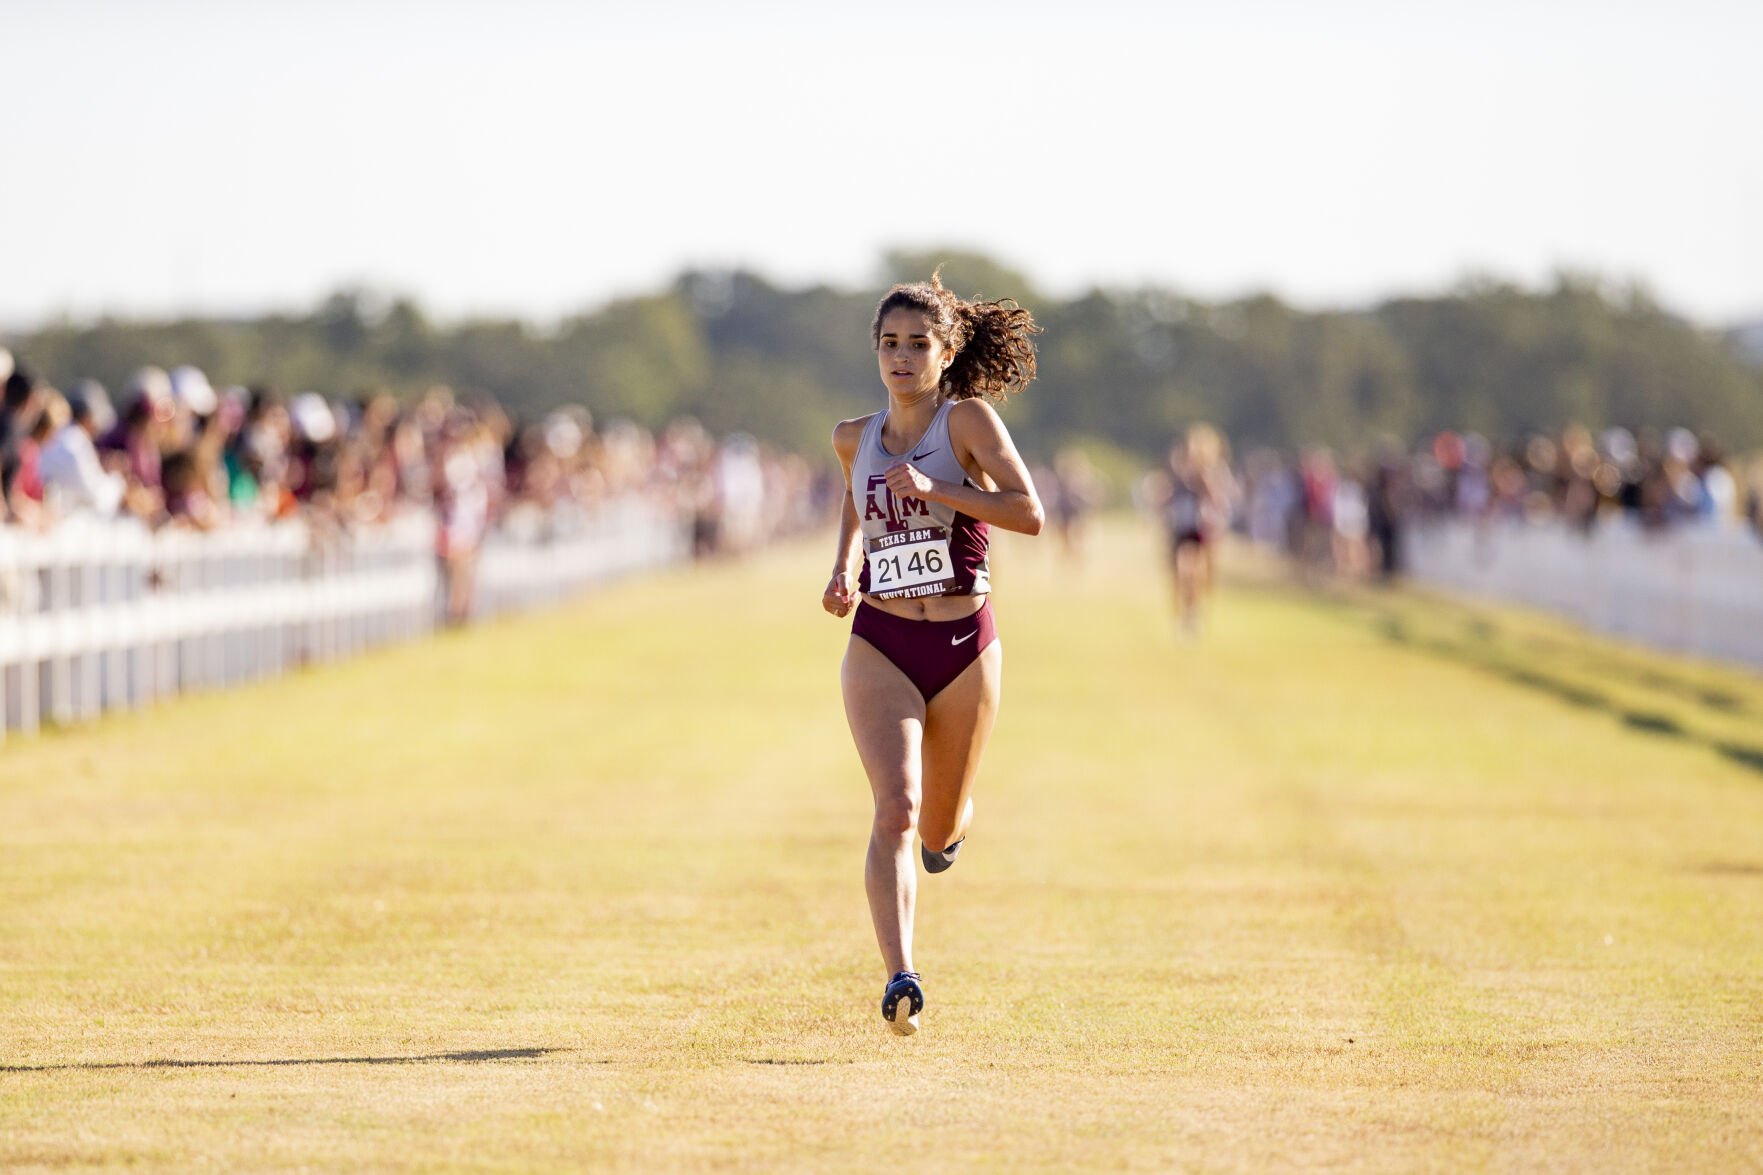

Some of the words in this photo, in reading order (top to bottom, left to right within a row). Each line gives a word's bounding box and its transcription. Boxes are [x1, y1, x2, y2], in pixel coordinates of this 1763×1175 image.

[878, 532, 906, 548] TEXAS
[909, 529, 931, 542] A&M
[878, 549, 943, 583] 2146
[879, 582, 946, 600] INVITATIONAL
